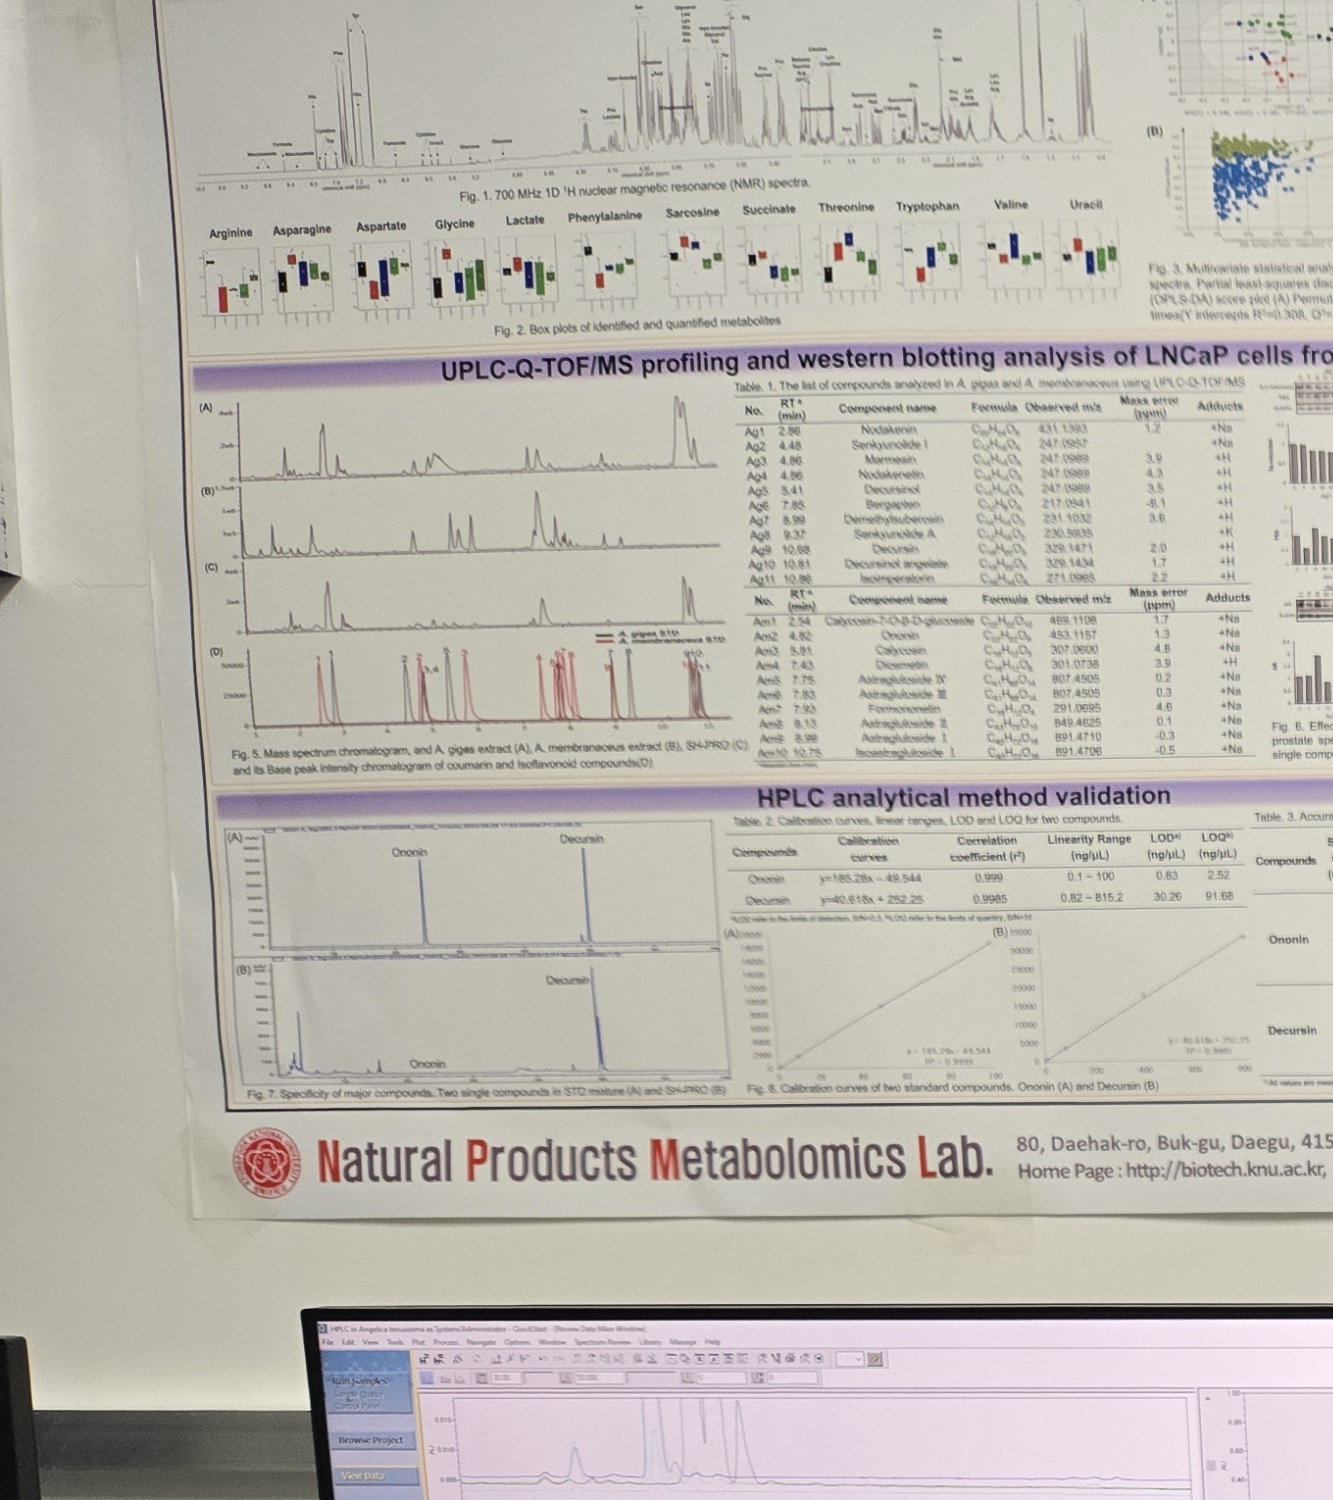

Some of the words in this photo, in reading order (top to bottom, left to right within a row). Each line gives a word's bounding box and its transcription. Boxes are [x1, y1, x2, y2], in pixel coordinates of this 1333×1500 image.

[568, 211, 643, 224] Phenylalanine
[666, 207, 720, 219] Sarcosine
[743, 203, 797, 216] Succinate
[818, 202, 875, 213] Threonine
[209, 227, 253, 241] Arginine
[273, 225, 332, 238] Asparagine
[356, 221, 407, 235] Aspartate
[435, 218, 475, 232] Glycine
[506, 214, 545, 227] Lactate
[441, 354, 633, 381] UPLC-Q-TOF/MS
[641, 351, 739, 378] profiling
[747, 349, 790, 371] and
[798, 349, 893, 369] western
[902, 347, 995, 371] blotting
[1004, 346, 1106, 371] analysis
[1114, 346, 1139, 367] of
[1146, 344, 1229, 366] LNCaP
[1237, 343, 1293, 365] cells
[757, 788, 825, 809] HPLC
[833, 787, 949, 812] analytical
[959, 786, 1048, 807] method
[1055, 785, 1171, 806] validation
[1016, 1136, 1046, 1154] 80,
[1051, 1135, 1152, 1154] Daehak-ro,
[1158, 1134, 1226, 1155] Buk-gu,
[1231, 1133, 1296, 1154] Daegu,
[318, 1138, 452, 1183] Natural
[467, 1137, 638, 1182] Products
[650, 1135, 907, 1182] Metabolomics
[918, 1134, 995, 1180] Lab.
[1018, 1162, 1071, 1180] Home
[1075, 1162, 1115, 1182] Page
